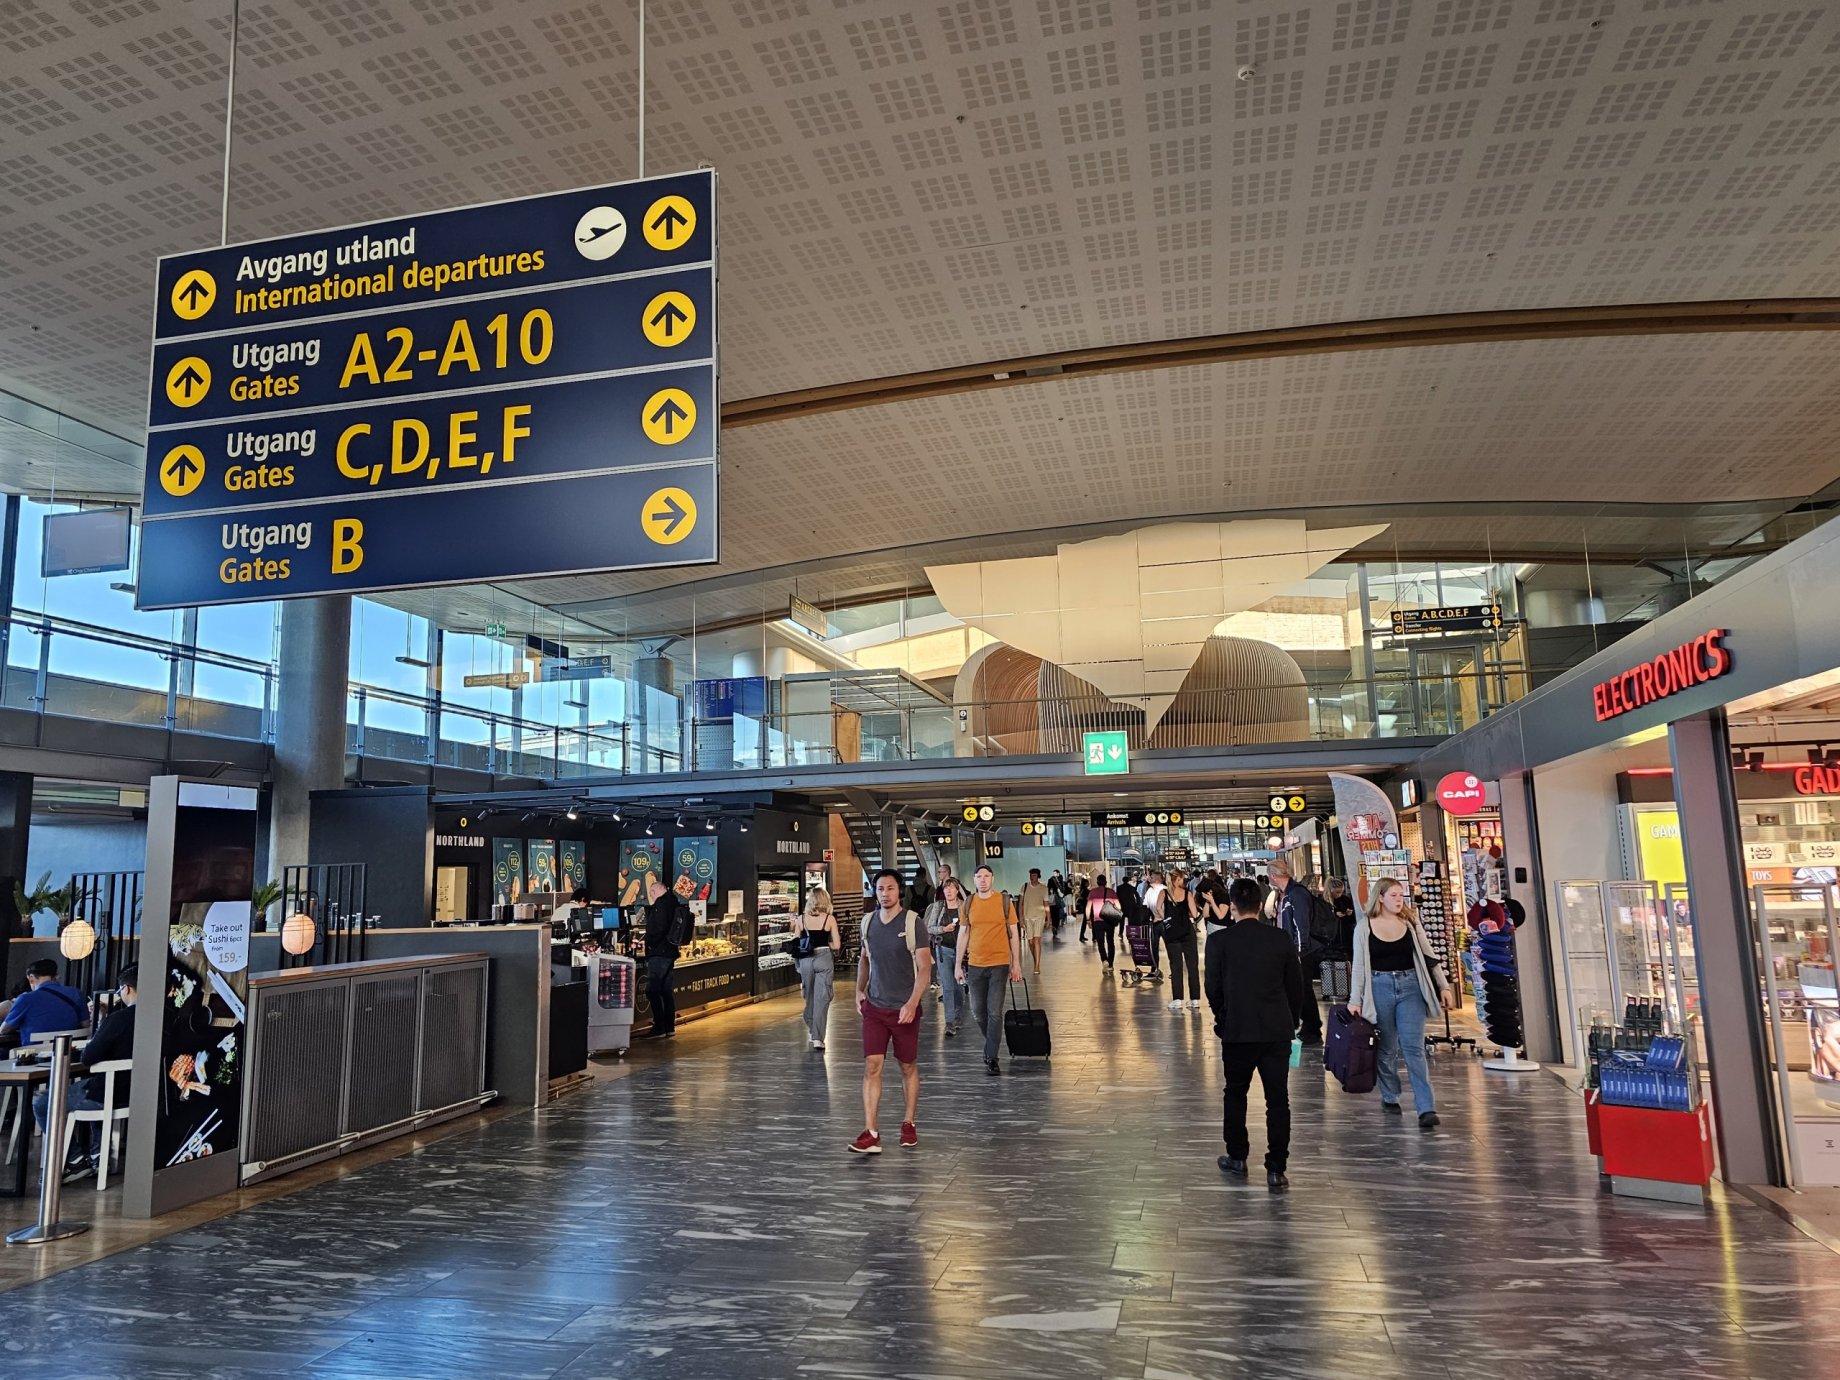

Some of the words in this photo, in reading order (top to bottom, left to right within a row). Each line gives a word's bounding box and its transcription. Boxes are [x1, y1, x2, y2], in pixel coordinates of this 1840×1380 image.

[236, 244, 328, 282] Avgang
[336, 227, 416, 266] utland
[234, 265, 394, 314] International
[402, 249, 546, 294] departures
[231, 338, 321, 373] Utgang
[338, 308, 554, 389] A2-A10
[229, 374, 300, 402] Gates
[226, 428, 317, 462] Utgang
[335, 404, 533, 486] C,D,E,F
[224, 464, 295, 492] Gates
[221, 521, 312, 554] Utgang
[330, 518, 365, 575] B
[219, 558, 291, 585] Gates
[1593, 629, 1729, 722] ELECTRONICS
[1795, 767, 1840, 794] GAD
[1443, 790, 1480, 799] CAPI
[436, 834, 485, 847] NORTHLAND
[776, 840, 810, 854] NORTHLAND
[1752, 871, 1773, 881] TOYS
[208, 934, 229, 943] Sushi
[211, 924, 228, 932] Take
[692, 980, 703, 992] FAST
[704, 977, 718, 989] TRACK
[719, 974, 730, 985] FOOD
